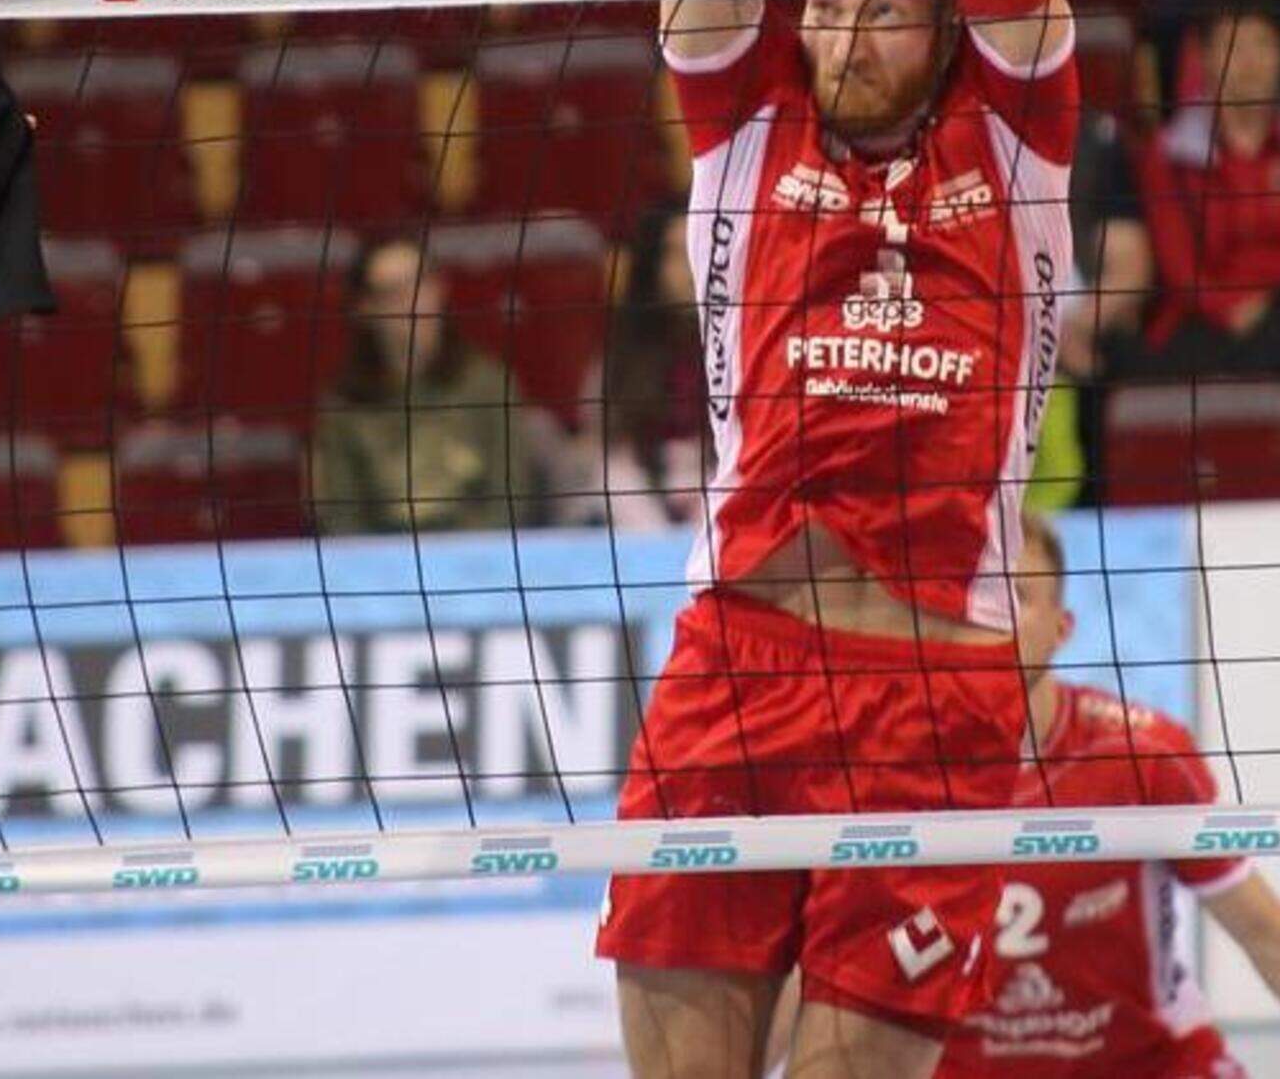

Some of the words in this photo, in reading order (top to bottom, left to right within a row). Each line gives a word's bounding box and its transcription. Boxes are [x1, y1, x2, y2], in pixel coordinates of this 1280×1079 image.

[786, 337, 975, 384] PETERHOFF
[830, 839, 918, 861] SWD
[1012, 834, 1100, 856] SWD
[471, 852, 559, 874] SWD
[651, 846, 738, 867] SWD
[112, 866, 198, 889] SWD
[291, 859, 379, 883] SWD
[994, 882, 1049, 959] 2
